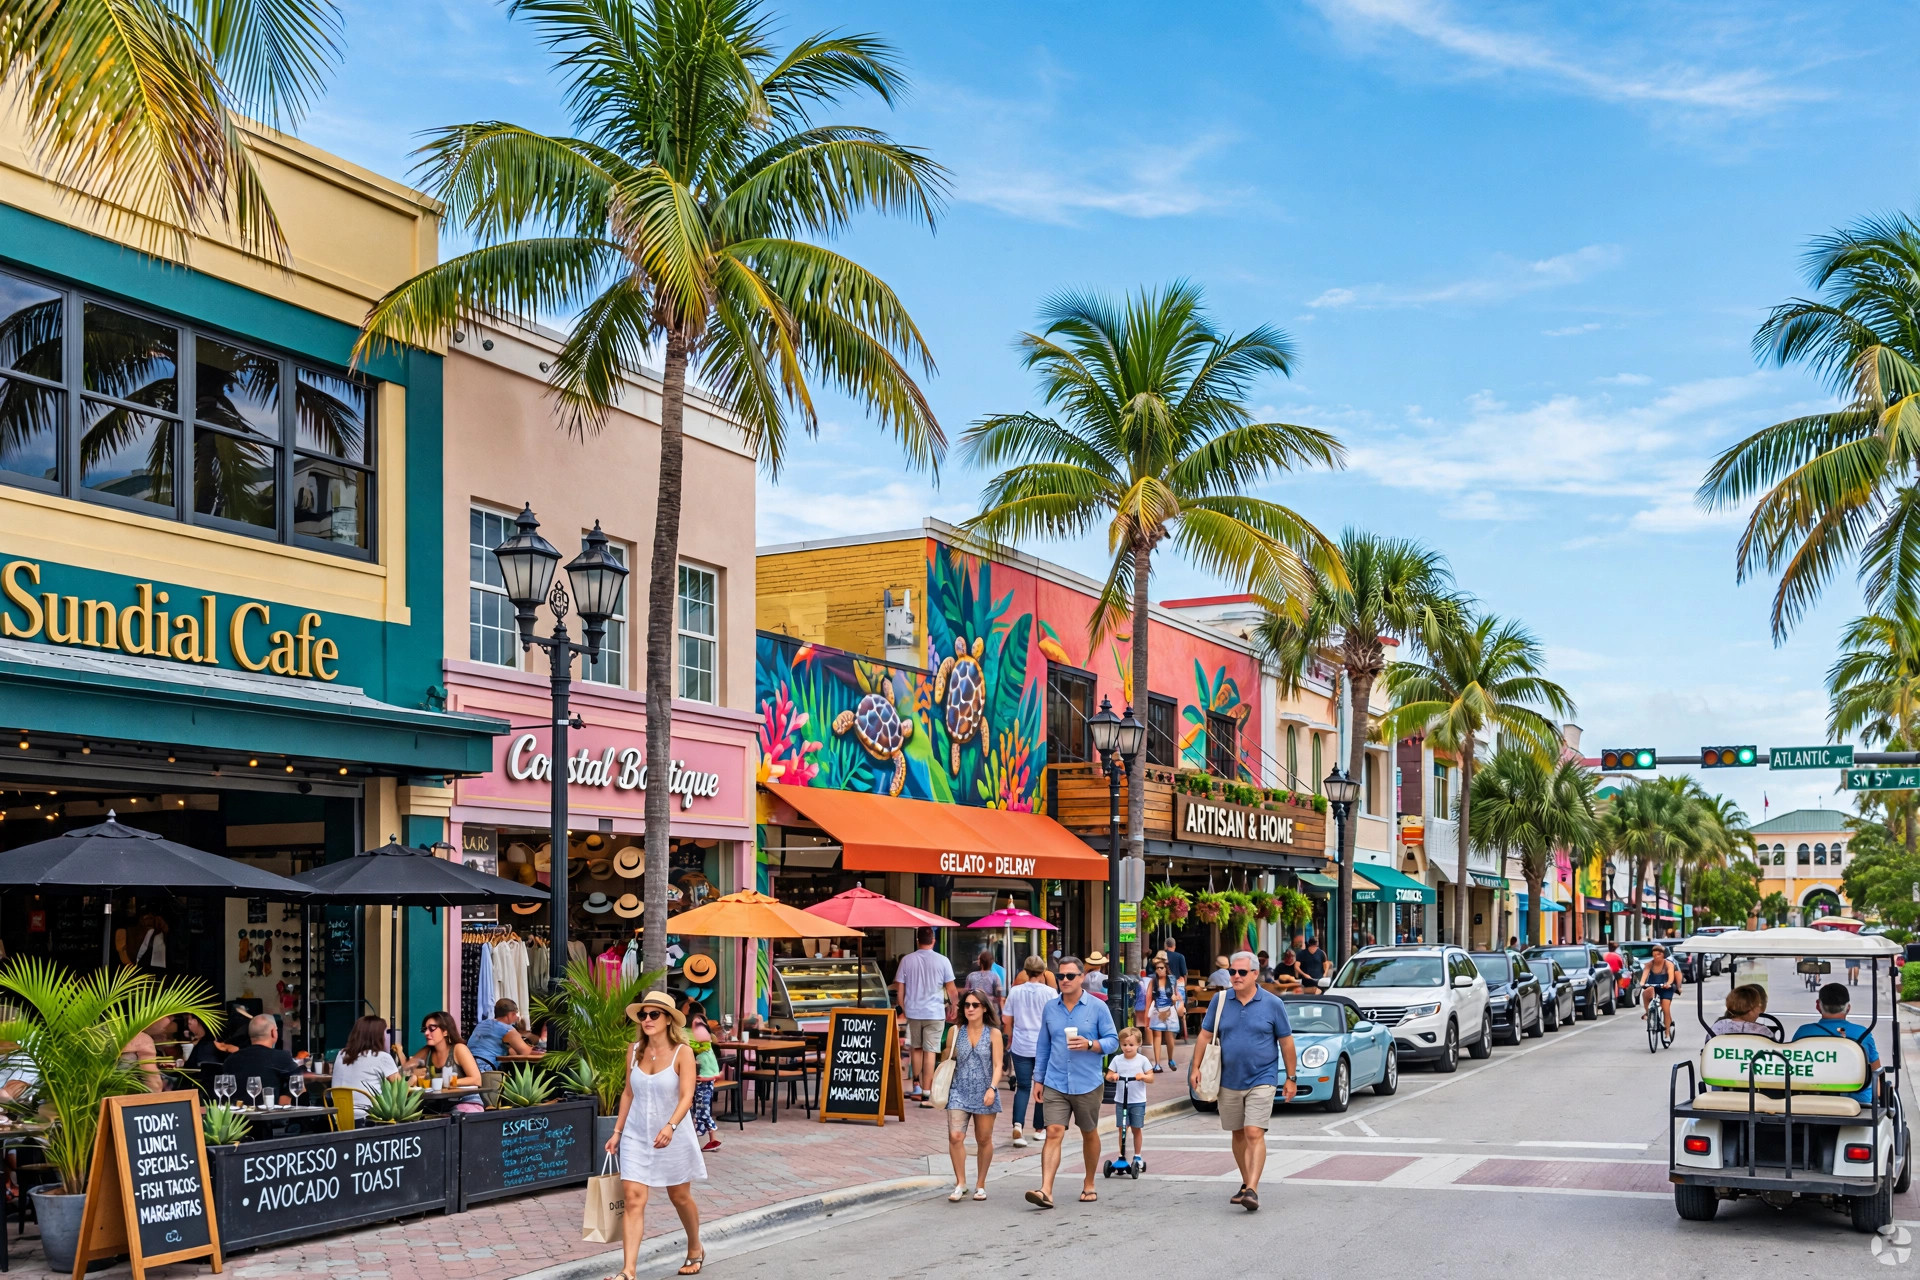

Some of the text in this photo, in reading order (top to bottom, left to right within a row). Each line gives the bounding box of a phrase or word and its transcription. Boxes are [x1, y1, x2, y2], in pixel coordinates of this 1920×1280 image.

[1, 560, 339, 681] Sundial Cafe
[1773, 750, 1851, 767] ATLANTIC AVE
[507, 733, 719, 809] Costal Botique
[1853, 773, 1870, 787] SW
[1898, 773, 1916, 787] AVE
[1186, 803, 1294, 845] ARTISAN & HOME
[940, 853, 1036, 876] GELATO DELRAY
[841, 1018, 876, 1032] TODAY:
[841, 1034, 872, 1048] LUNCH
[1783, 1049, 1837, 1063] BEACH
[833, 1068, 880, 1082] FISH TACOS
[829, 1086, 880, 1102] MARGARITAS
[134, 1113, 179, 1134] TODAY:
[137, 1134, 177, 1155] LUNCH
[243, 1136, 422, 1184] ESSPRESSO PASTRIES
[257, 1165, 404, 1213] AVOCADO TOAST
[140, 1199, 202, 1225] MARGARITAS
